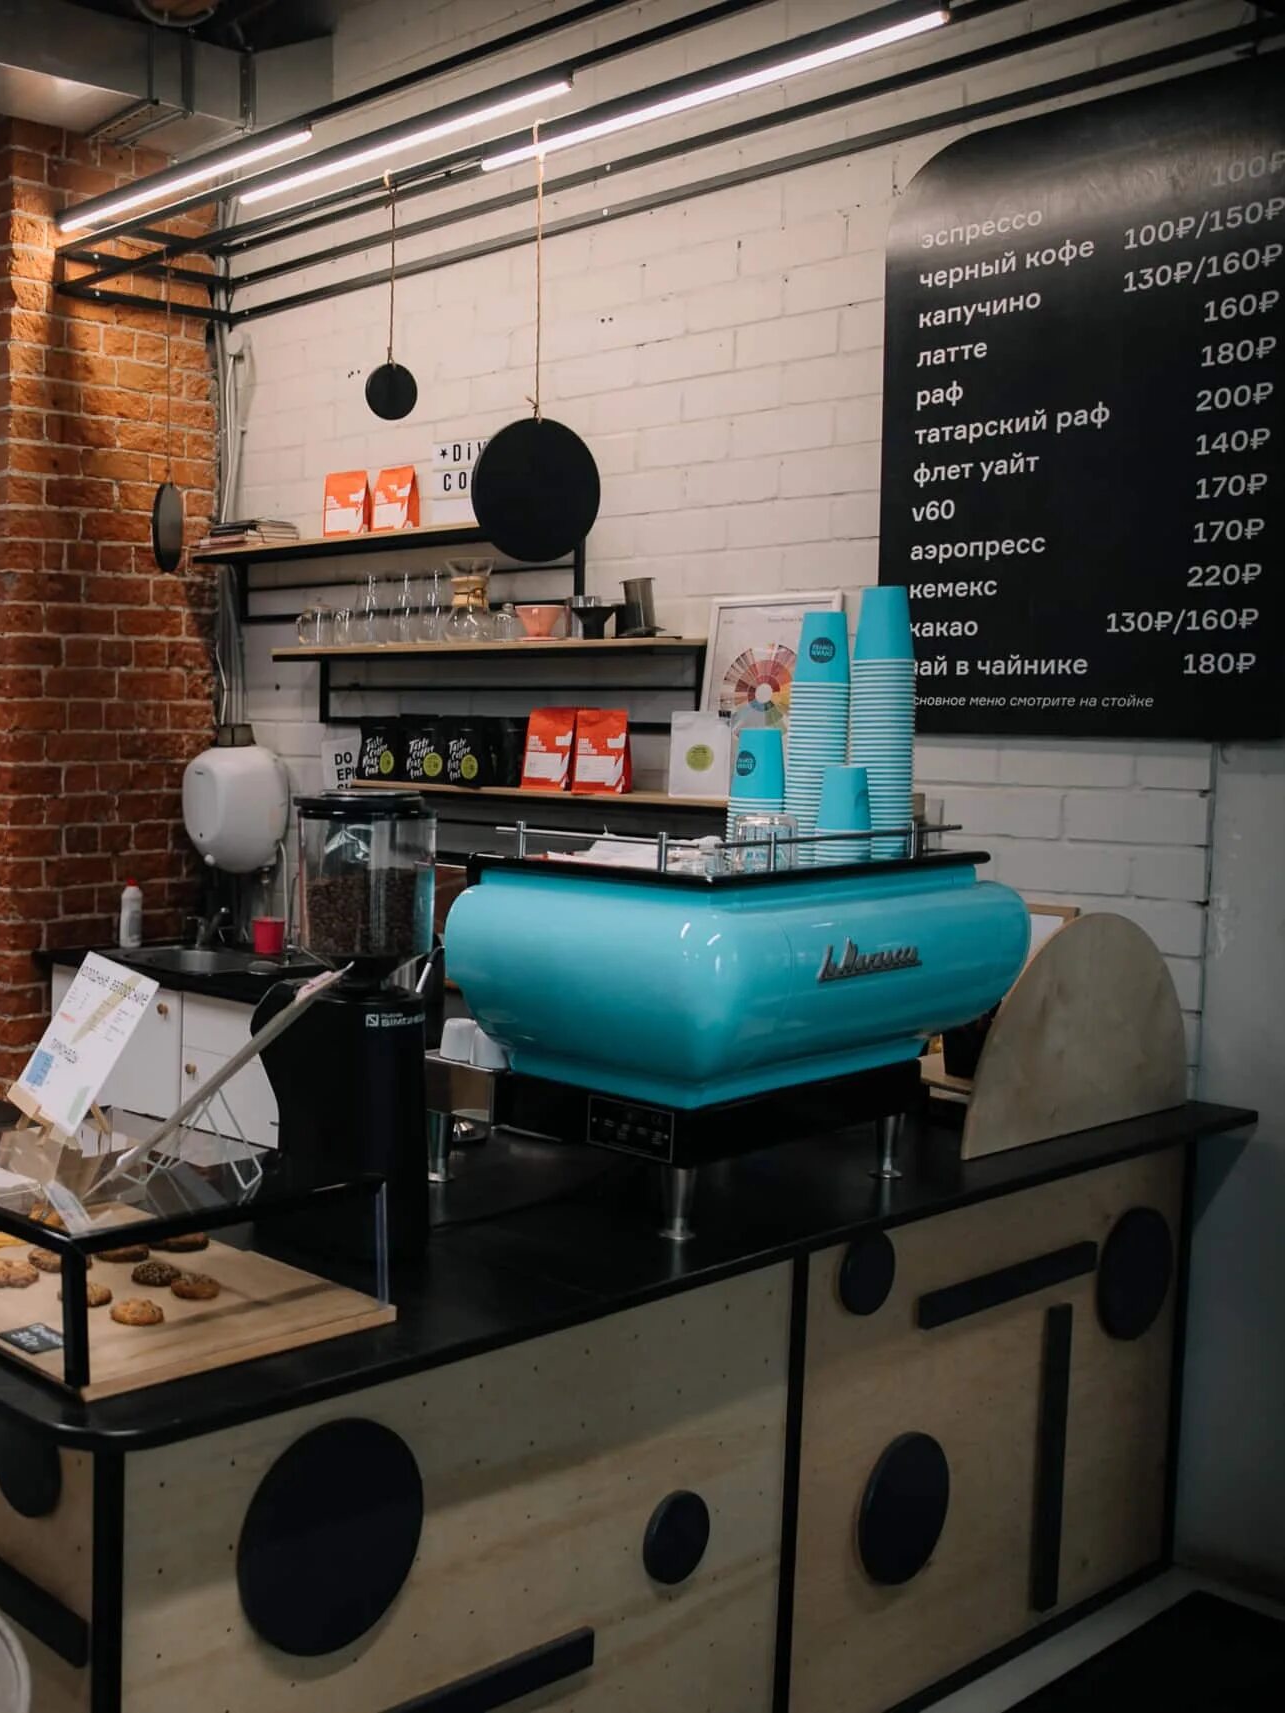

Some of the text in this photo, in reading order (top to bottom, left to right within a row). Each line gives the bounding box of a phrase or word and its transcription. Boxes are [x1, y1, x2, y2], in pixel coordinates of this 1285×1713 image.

[921, 210, 1043, 250] эспрессо
[1123, 197, 1285, 251] 100₽/150₽
[918, 238, 1096, 290] черный кофе
[1122, 243, 1284, 293] 130₽/160₽
[918, 292, 1042, 329] капучино
[1203, 289, 1280, 323] 160₽
[916, 341, 988, 369] латте
[1200, 335, 1277, 368] 180₽
[915, 379, 964, 412] раф
[1195, 381, 1274, 413] 200₽
[914, 400, 1111, 446] татарский раф
[452, 441, 487, 462] DiV
[1195, 427, 1272, 457] 140₽
[443, 471, 467, 491] CO
[912, 452, 1041, 489] флет уайт
[1195, 472, 1268, 500] 170₽
[911, 498, 956, 525] v60
[1193, 517, 1266, 547] 170₽
[909, 536, 1047, 565] аэропресс
[909, 579, 998, 600] кемекс
[1186, 562, 1263, 589] 220₽
[1106, 607, 1260, 636] 130₽/160₽
[955, 659, 970, 677] в
[976, 653, 1090, 677] чайнике
[1182, 652, 1257, 676] 180₽
[913, 692, 1155, 710] сновное меню смотрите на стойке
[334, 751, 353, 766] DO
[336, 766, 356, 781] EPI
